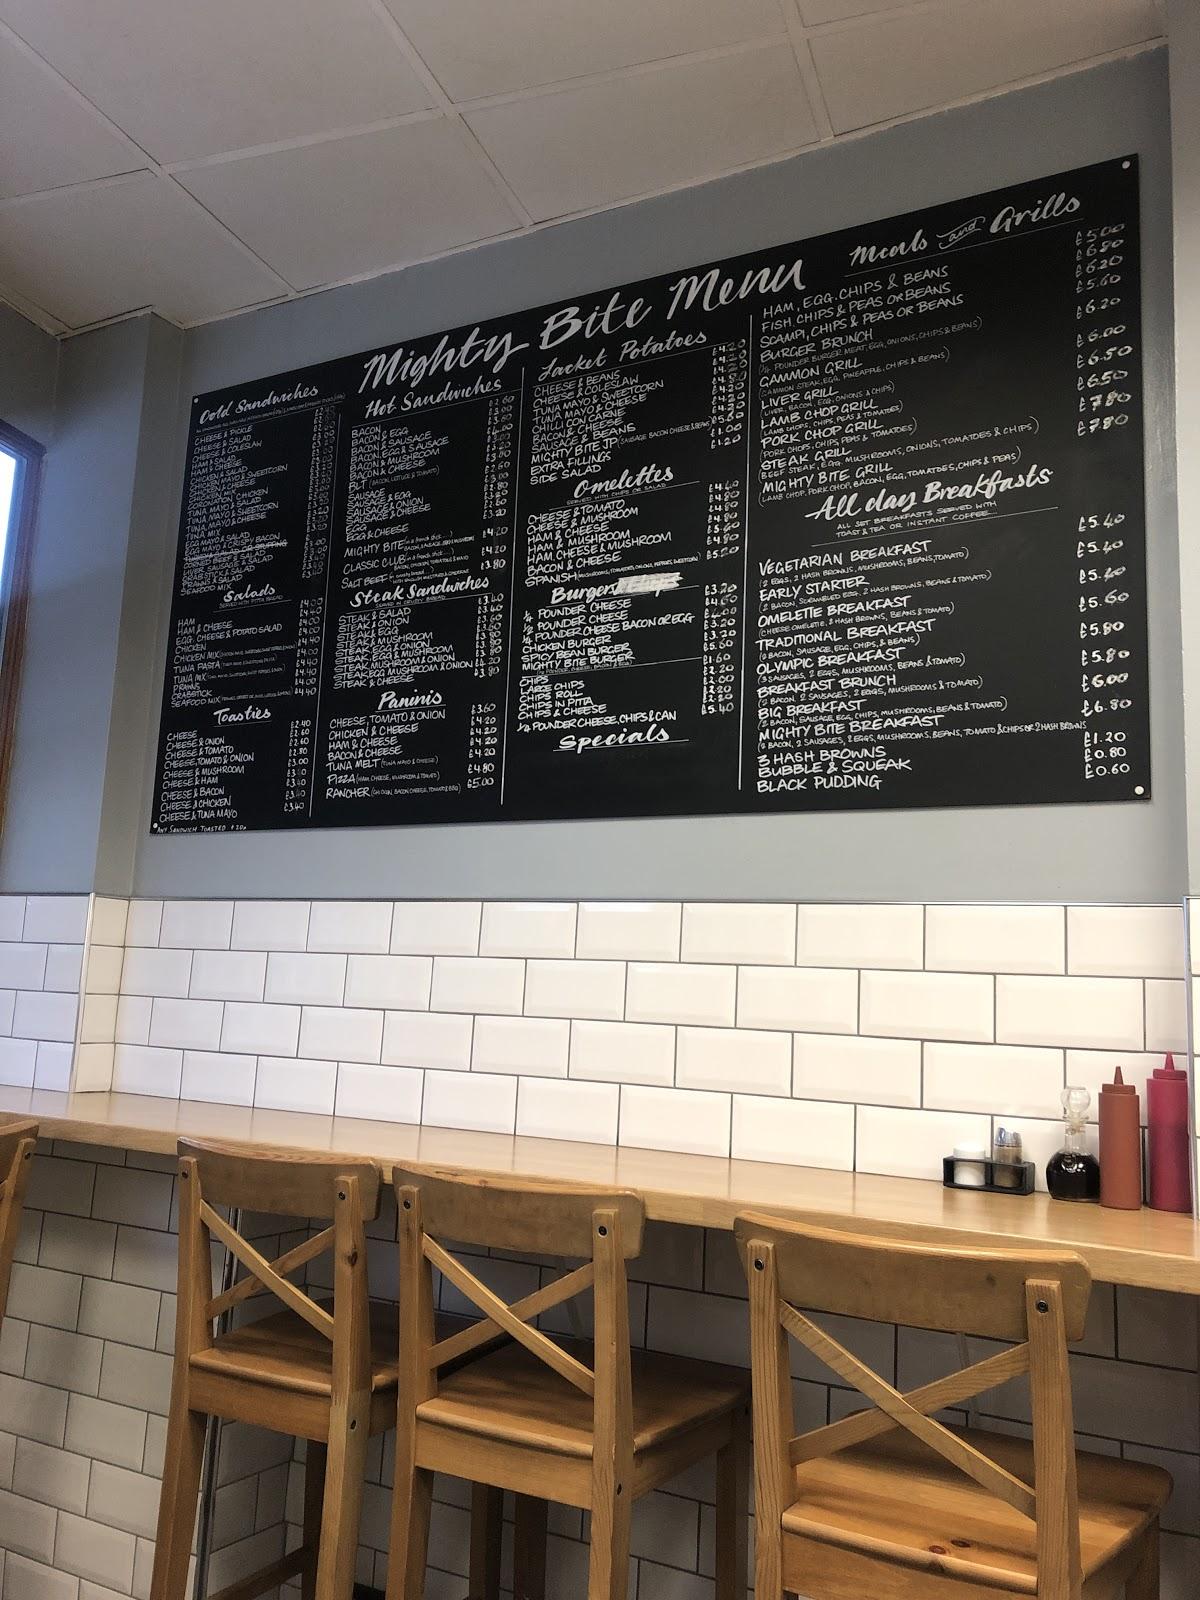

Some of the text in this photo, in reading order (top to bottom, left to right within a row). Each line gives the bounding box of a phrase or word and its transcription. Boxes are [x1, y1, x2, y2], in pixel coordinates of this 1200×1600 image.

[849, 229, 928, 266] Meals
[989, 192, 1080, 233] Grills
[839, 280, 883, 300] CHIPS
[887, 273, 899, 290] &
[903, 265, 948, 285] BEANS
[358, 259, 806, 394] Mighty Bite Menu
[811, 318, 847, 337] CHIPS
[850, 314, 859, 328] &
[862, 310, 898, 325] PEAS
[896, 305, 914, 317] OR
[916, 294, 964, 313] BEANS
[538, 330, 707, 382] Jacket Potatoes
[760, 328, 873, 363] BURGER BRUNCH
[759, 357, 863, 388] GAMMON GRILL
[199, 400, 233, 424] Cold
[235, 383, 318, 414] Sandwiches
[365, 395, 397, 419] Hot
[401, 375, 502, 411] Sandwiches
[761, 386, 839, 410] LIVER GRILL
[566, 415, 587, 428] CON
[588, 407, 626, 422] CARNE
[761, 398, 879, 430] LAMB CHOP GRILL
[351, 424, 381, 439] BACON
[760, 419, 884, 449] PORK CHOP GRILL
[530, 451, 611, 476] EXTRA FILLINGS
[759, 447, 852, 473] STEAK GRILL
[530, 464, 602, 485] SIDE SALAD
[574, 463, 674, 498] Omelettes
[759, 463, 893, 496] MIGHTY BITE GRILL
[348, 487, 385, 502] SAUSAGE
[804, 464, 1053, 520] All day Breakfasts
[854, 519, 871, 527] SET
[873, 510, 933, 524] BREAKFASTS
[936, 504, 972, 514] SERVED
[975, 500, 997, 509] WITH
[835, 529, 860, 538] TOAST
[869, 525, 886, 533] TEA
[907, 516, 948, 527] INSTANT
[343, 543, 380, 558] MIGHTY
[383, 538, 406, 553] BITE
[528, 529, 630, 555] HAM & MUSHROOM
[343, 559, 380, 575] CLASSIC
[527, 561, 564, 577] BACON
[566, 559, 574, 571] &
[575, 551, 622, 568] CHEESE
[759, 540, 932, 576] VEGETARIAN BREAKFAST
[223, 583, 275, 602] Salads
[349, 585, 404, 608] Steak
[406, 575, 489, 599] Sandwiches
[759, 575, 870, 602] EARLY STARTER
[538, 598, 632, 619] POUNDER CHEESE
[758, 595, 912, 627] OMELETTE BREAKFAST
[1078, 590, 1129, 612] £5.60
[338, 607, 411, 626] STEAK SALAD
[258, 623, 282, 634] SALAD
[755, 618, 936, 651] TRADITIONAL BREAKFAST
[175, 642, 207, 654] CHICKEN
[521, 642, 632, 663] SPICY BEAN BURGER
[522, 634, 612, 654] CHICKEN BURGER
[756, 647, 906, 676] OLYMPIC BREAKFAST
[520, 680, 585, 695] LARGE CHIPS
[756, 674, 896, 698] BREAKFAST BRUNCH
[1081, 672, 1129, 692] £6.00
[378, 689, 442, 710] Paninis
[758, 699, 867, 720] BIG BREAKFAST
[1081, 699, 1132, 717] £6.80
[213, 705, 271, 725] Toasties
[167, 730, 197, 741] CHEESE
[328, 722, 419, 740] CHICKEN & CHEESE
[556, 723, 670, 754] Specials
[757, 714, 945, 742] MIGHTY BITE BREAKFAST
[1084, 731, 1126, 747] £1.20
[757, 745, 887, 767] 3 HASH BROWNS
[1084, 745, 1127, 762] £0.80
[201, 765, 245, 776] MUSHROOM
[325, 758, 381, 772] TUNA MELT
[758, 758, 912, 778] BUBBLE & SQUEAK
[1085, 761, 1130, 779] £0.60
[199, 786, 225, 797] BACON
[200, 776, 218, 785] HAM
[757, 774, 883, 793] BLACK PUDDING
[326, 787, 371, 799] RANCHER
